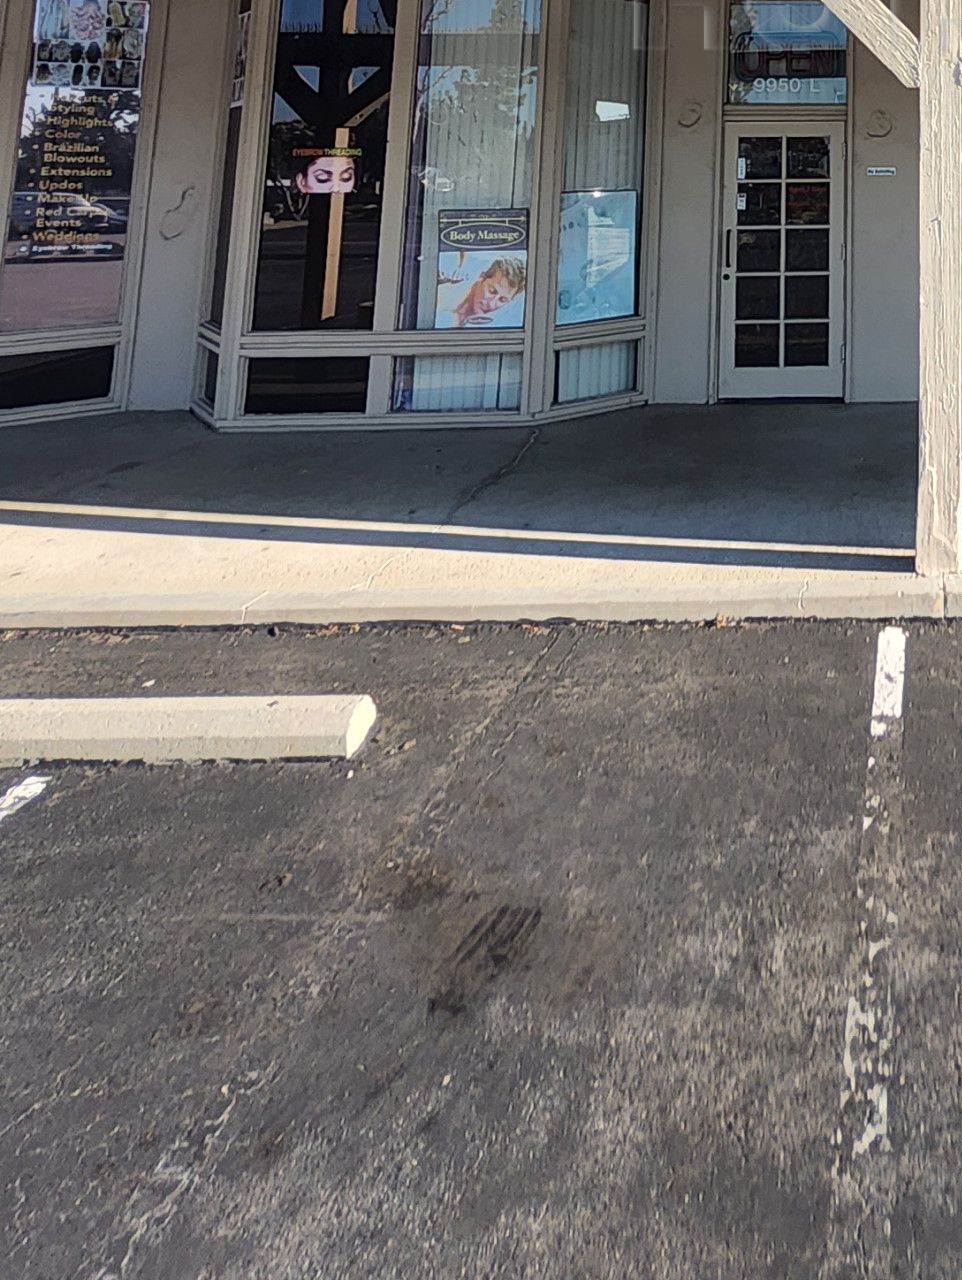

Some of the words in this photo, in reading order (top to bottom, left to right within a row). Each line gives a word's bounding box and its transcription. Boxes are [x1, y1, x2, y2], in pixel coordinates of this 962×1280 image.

[752, 77, 801, 93] 9950
[809, 79, 821, 93] L
[51, 105, 96, 116] Styling
[47, 116, 114, 128] Highlights
[45, 129, 82, 139] Color
[43, 142, 100, 154] Brazilian
[43, 153, 106, 164] Blowouts
[40, 166, 113, 177] Extensions
[38, 179, 84, 191] Updos
[36, 205, 63, 216] Red
[35, 217, 82, 228] Events
[33, 231, 100, 243] Weddings
[449, 230, 476, 243] Body
[477, 230, 520, 242] Massage
